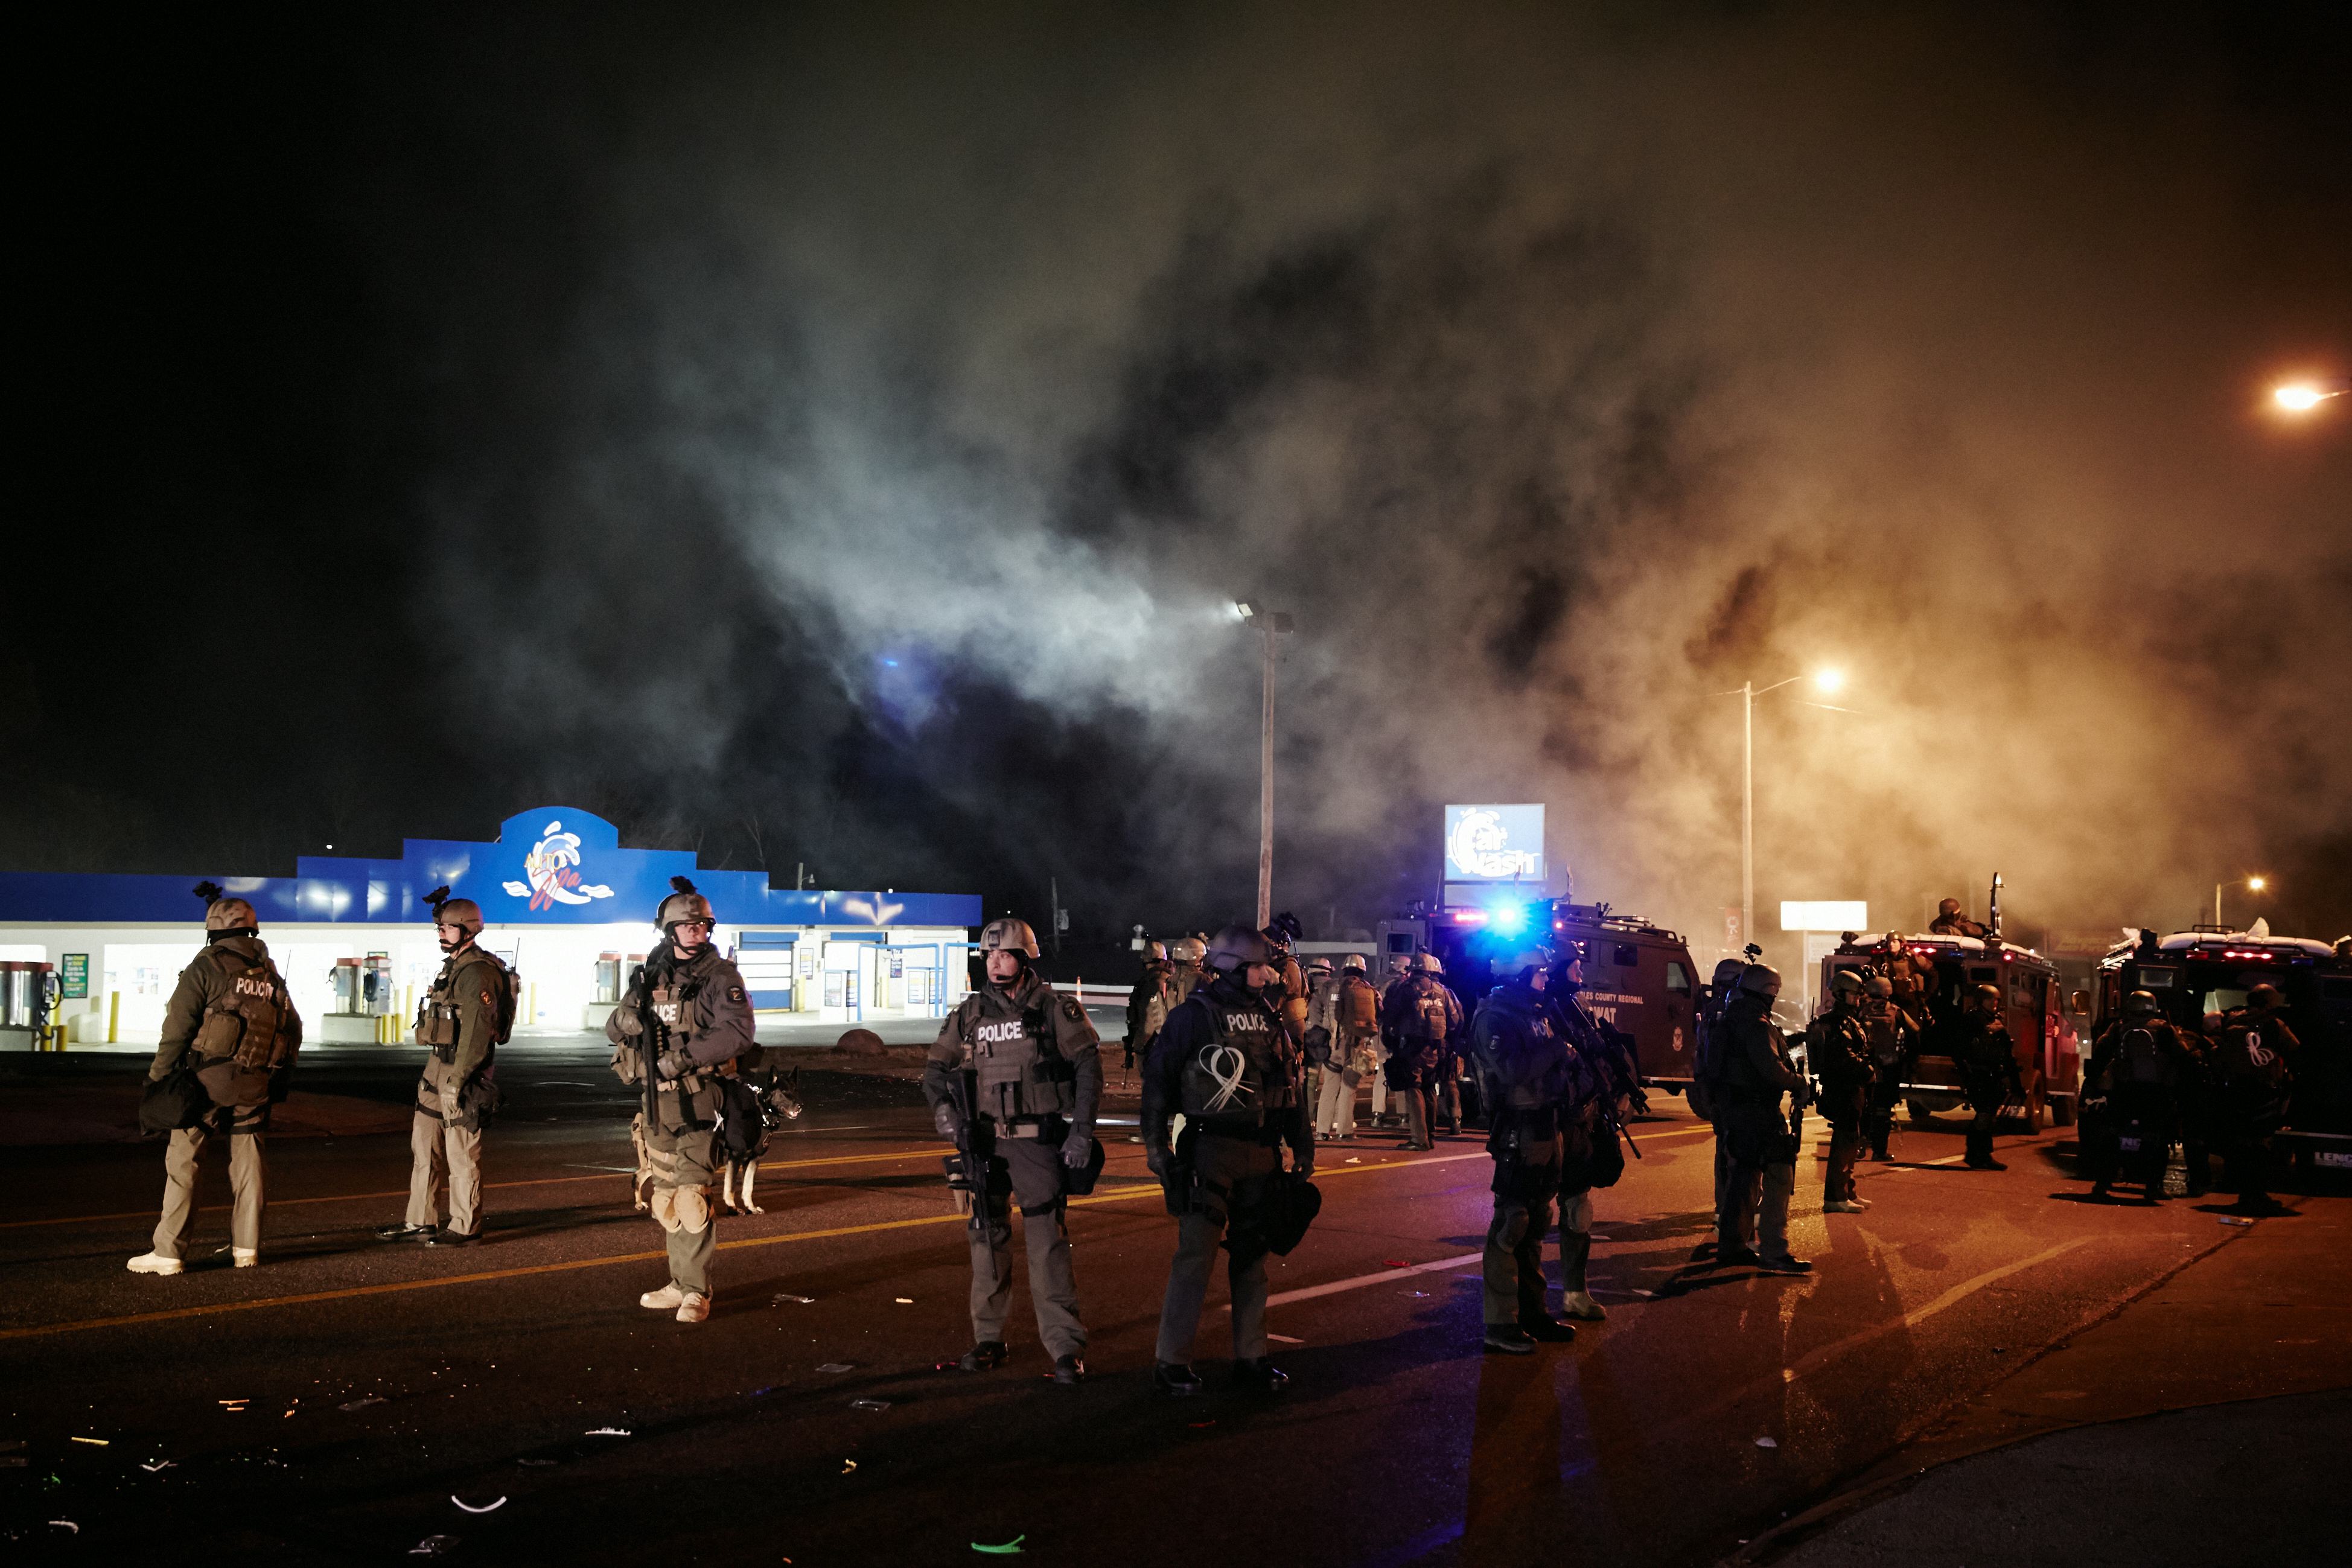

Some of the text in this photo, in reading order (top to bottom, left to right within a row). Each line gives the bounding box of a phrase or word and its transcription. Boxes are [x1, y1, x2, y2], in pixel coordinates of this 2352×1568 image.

[523, 853, 561, 870] AUTO
[529, 864, 582, 911] Spa
[1595, 992, 1617, 1002] COUNTY
[1618, 994, 1643, 1005] REGIONAL
[1589, 1006, 1617, 1029] WAT
[978, 1021, 1022, 1042] POLICE
